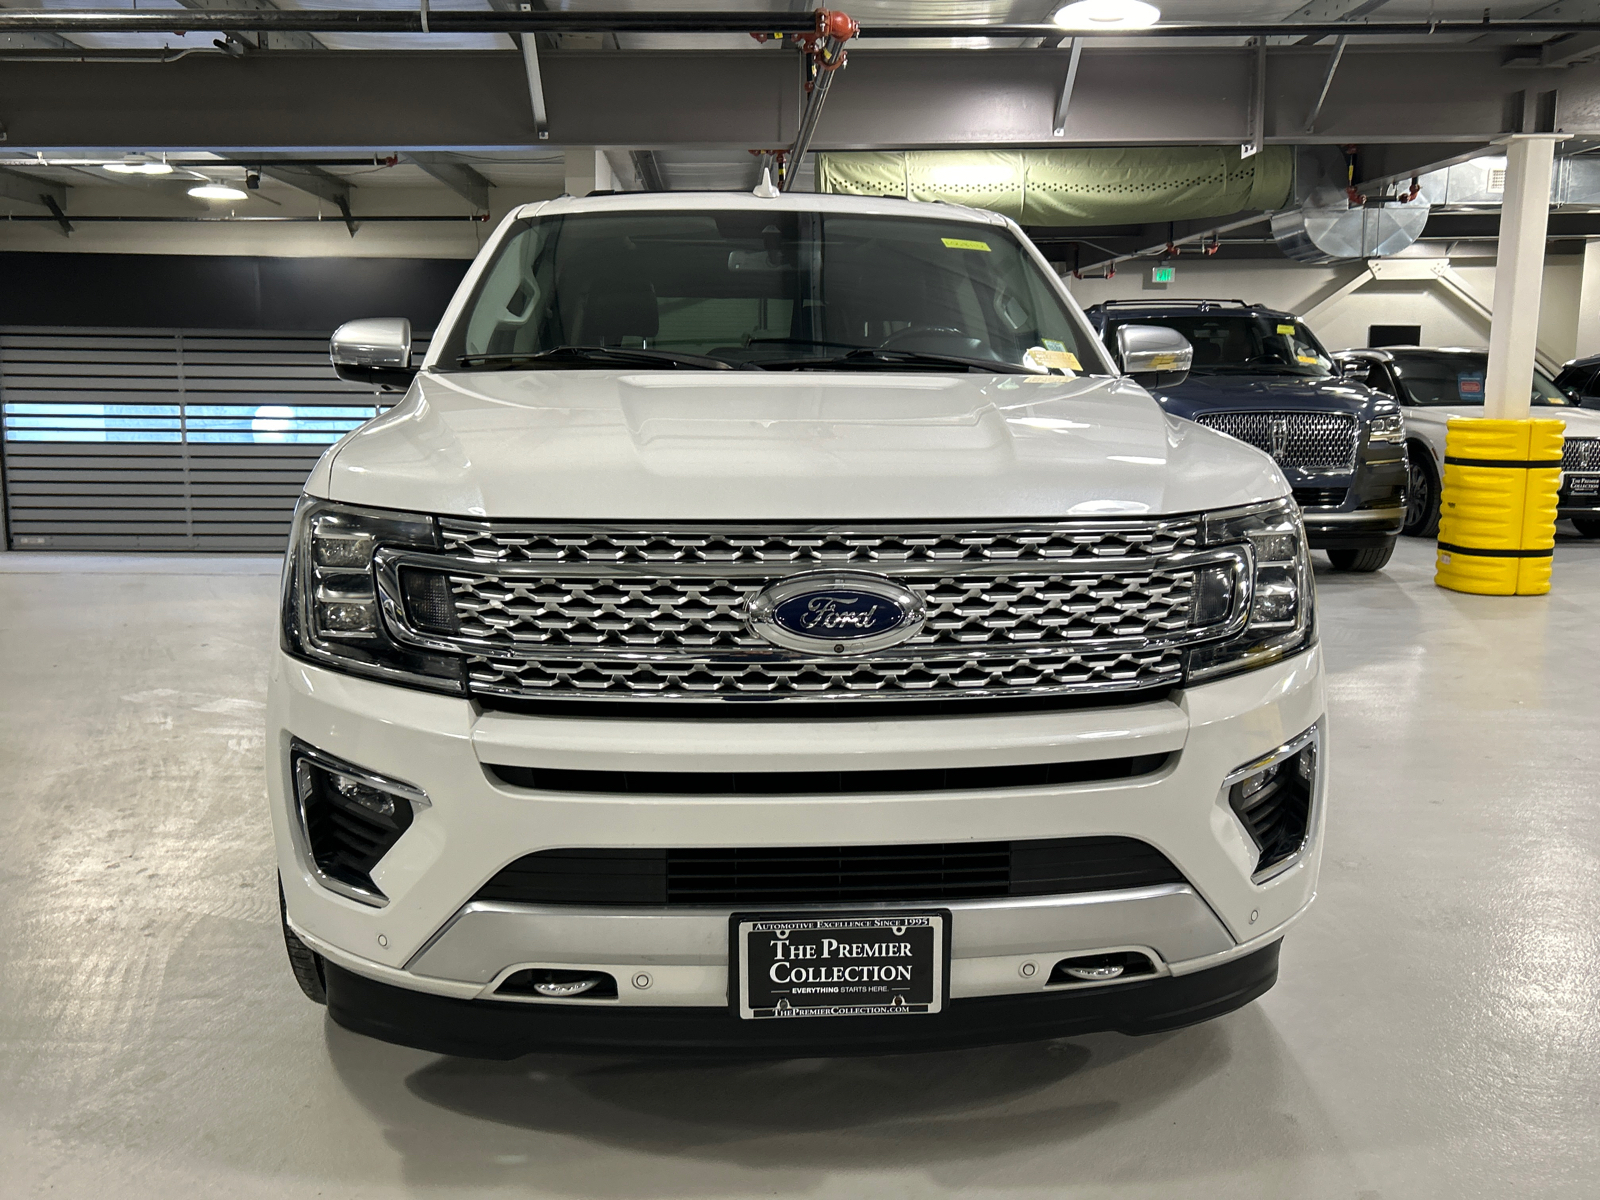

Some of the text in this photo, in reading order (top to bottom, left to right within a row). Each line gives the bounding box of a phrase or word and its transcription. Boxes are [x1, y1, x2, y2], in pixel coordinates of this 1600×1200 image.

[800, 596, 878, 629] Ford
[755, 918, 928, 930] AUTOMOTIVE EXCELLENCE SINCE 1995
[770, 938, 913, 960] THE PREMIER
[769, 961, 913, 984] COLLECTION
[792, 986, 839, 994] EVERYTHING
